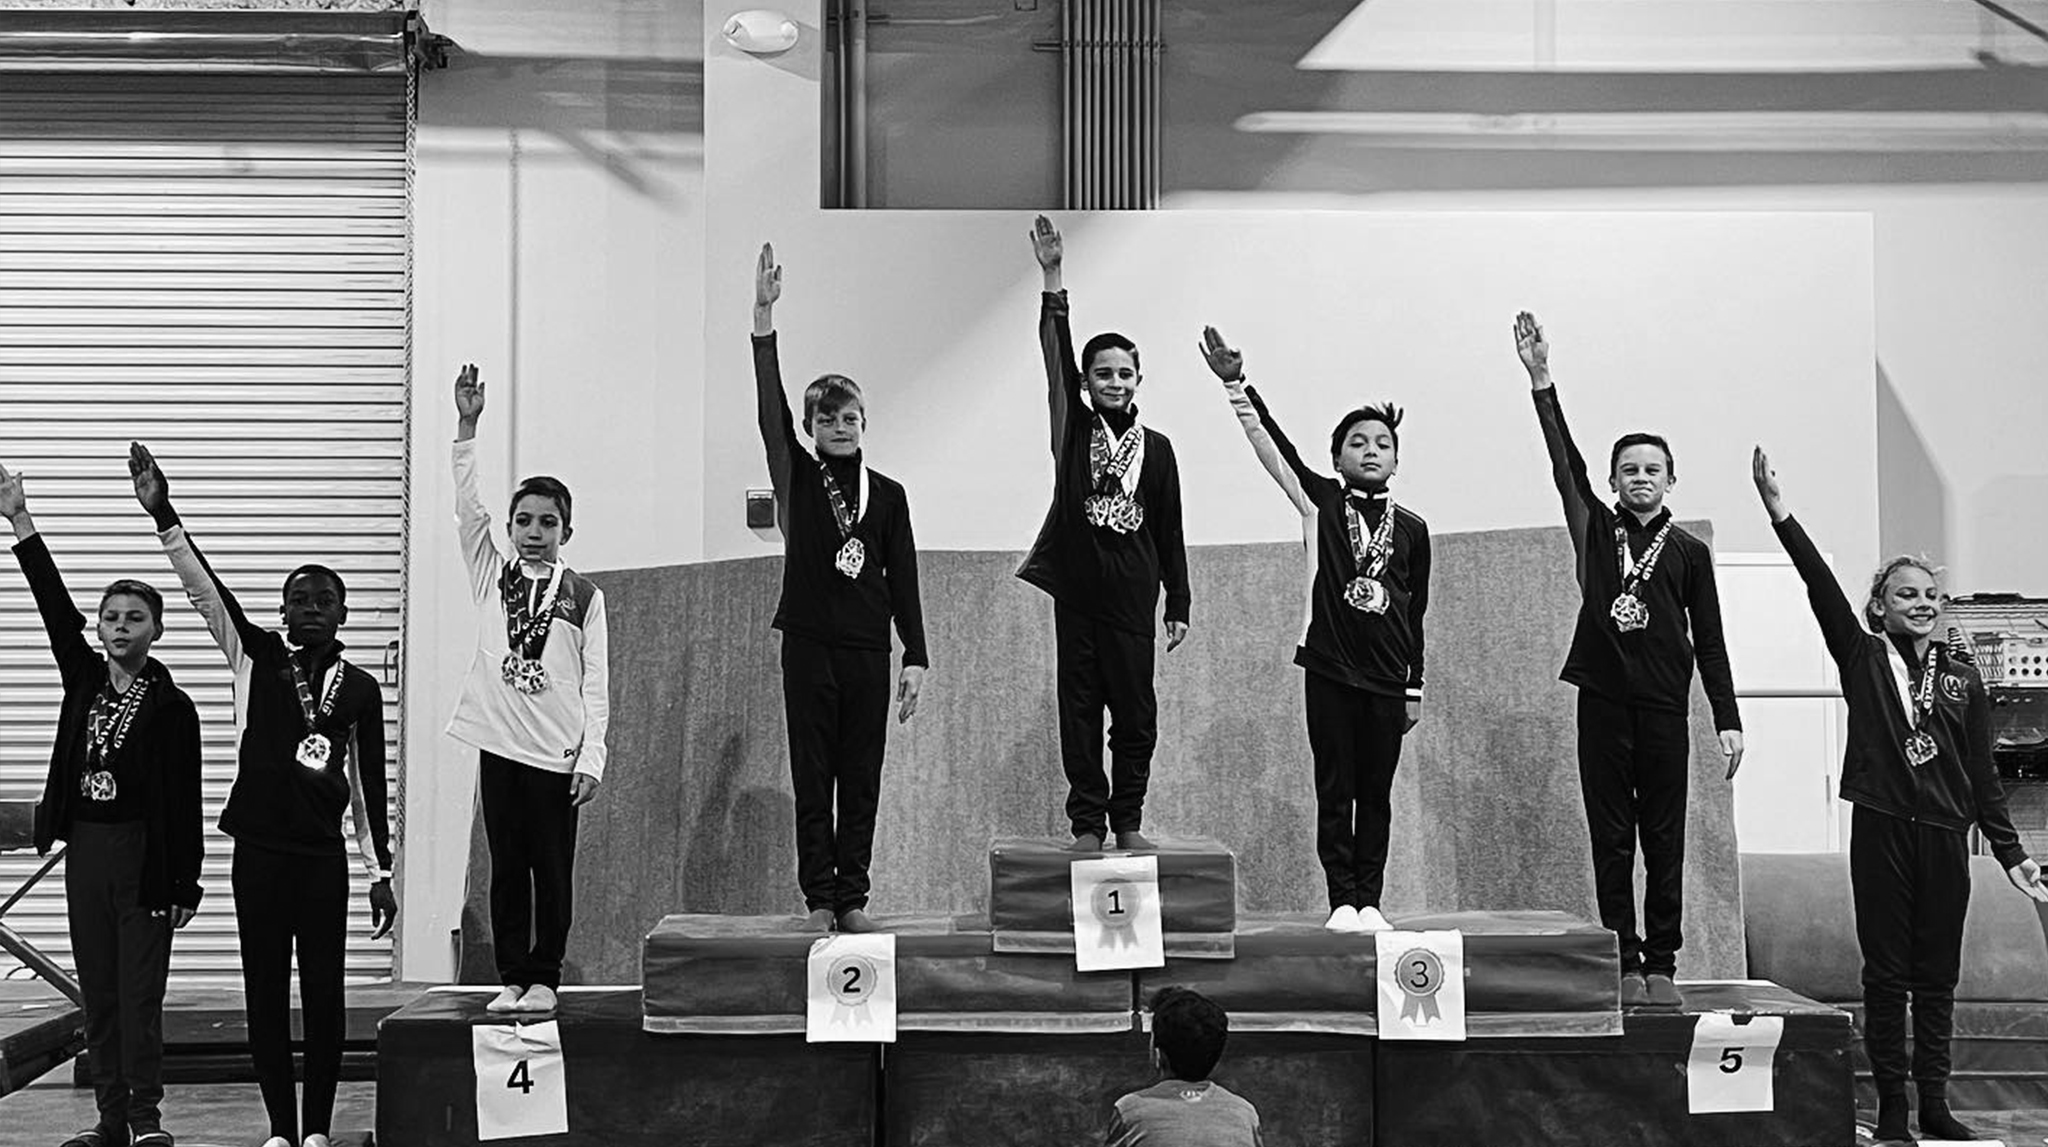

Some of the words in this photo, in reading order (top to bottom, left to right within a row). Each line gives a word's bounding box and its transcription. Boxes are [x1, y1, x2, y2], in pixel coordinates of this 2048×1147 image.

[1108, 890, 1125, 914] 1
[842, 966, 861, 993] 2
[1410, 960, 1429, 988] 3
[1719, 1047, 1744, 1074] 5
[507, 1060, 534, 1094] 4
